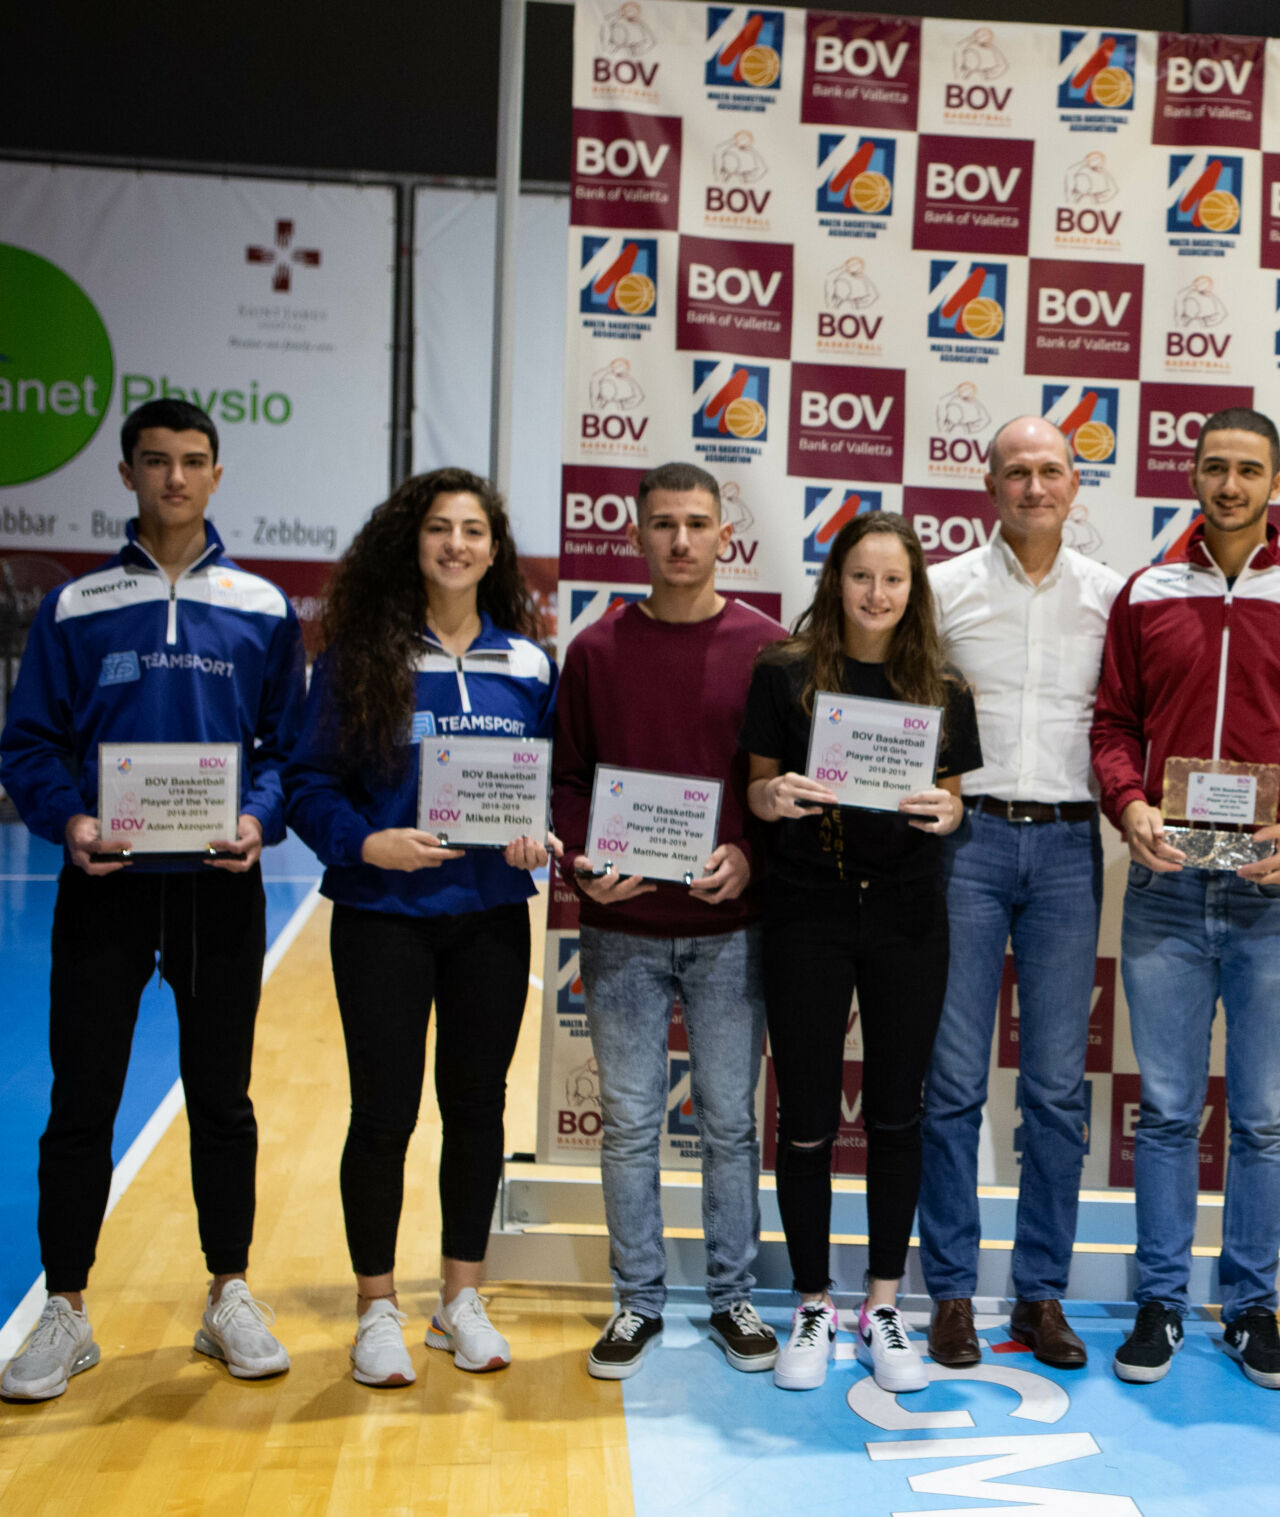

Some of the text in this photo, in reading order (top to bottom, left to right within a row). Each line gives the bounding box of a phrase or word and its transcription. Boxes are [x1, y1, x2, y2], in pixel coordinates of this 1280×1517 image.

[815, 37, 908, 77] BOV
[594, 57, 659, 87] BOV
[1167, 57, 1252, 94] BOV
[946, 84, 1012, 111] BOV
[1163, 104, 1253, 121] Bank of Valletta
[577, 138, 669, 177] BOV
[926, 163, 1021, 202] BOV
[706, 187, 770, 214] BOV
[705, 214, 770, 226] BASKETBALL
[1056, 207, 1121, 235] BOV
[689, 263, 781, 306] BOV
[1038, 288, 1131, 326] BOV
[818, 313, 882, 340] BOV
[817, 340, 882, 352] BASKETBALL
[931, 344, 953, 353] MALTA
[1036, 336, 1130, 352] Bank of Valletta
[1166, 332, 1230, 358] BOV
[1165, 359, 1230, 370] BASKETBALL
[801, 391, 893, 430] BOV
[582, 414, 648, 441] BOV
[581, 441, 648, 452] BASKETBALL
[799, 438, 892, 456] Bank of Valletta
[929, 437, 990, 462] BOV
[913, 515, 1001, 552] BOV
[141, 652, 235, 678] TEAMSPORT
[438, 715, 525, 736] TEAMSPORT
[903, 718, 929, 730] BOV
[852, 731, 925, 747] BOV Basketball
[513, 753, 538, 763] BOV
[846, 750, 923, 768] Player the Year
[890, 746, 907, 755] Girls
[462, 770, 536, 780] BOV Basketball
[816, 767, 848, 782] BOV
[883, 780, 911, 791] Bonett
[458, 790, 535, 800] Player the Year
[684, 790, 709, 802] BOV
[429, 809, 461, 821] BOV
[466, 813, 532, 825] Mikela Riolo
[633, 803, 705, 819] BOV Basketball
[111, 818, 145, 830] BOV
[627, 822, 703, 839] Player the Year
[597, 838, 629, 853] BOV
[633, 847, 698, 862] Matthew Attard
[558, 1110, 602, 1136] BO
